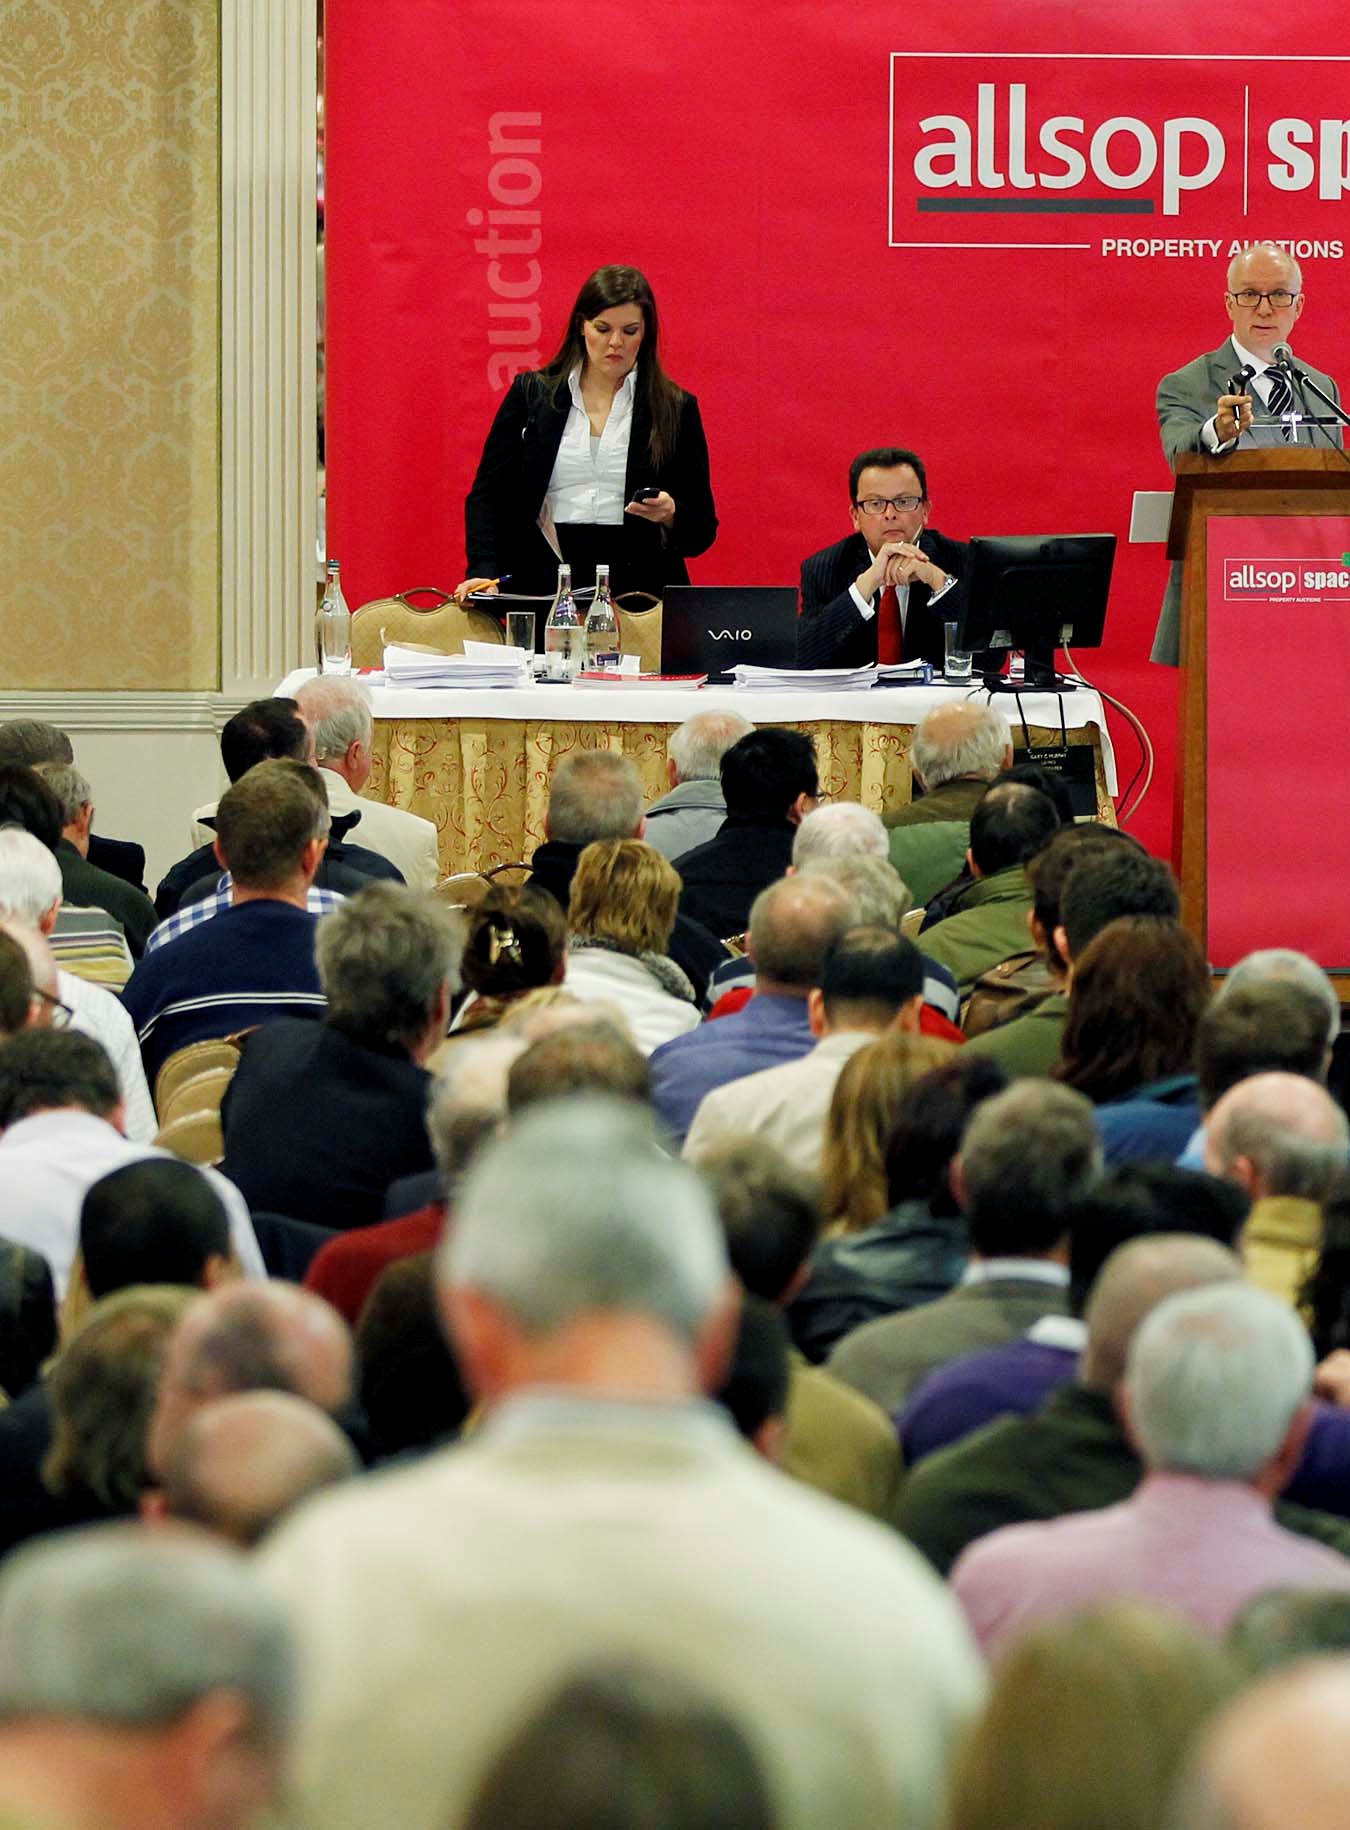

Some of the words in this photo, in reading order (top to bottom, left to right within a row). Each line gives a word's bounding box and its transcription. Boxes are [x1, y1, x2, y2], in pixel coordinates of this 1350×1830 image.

[913, 83, 1226, 215] allsop
[466, 111, 542, 392] auction
[1102, 239, 1222, 257] PROPERTY
[1229, 565, 1296, 593] allsop
[708, 629, 752, 641] VAIO
